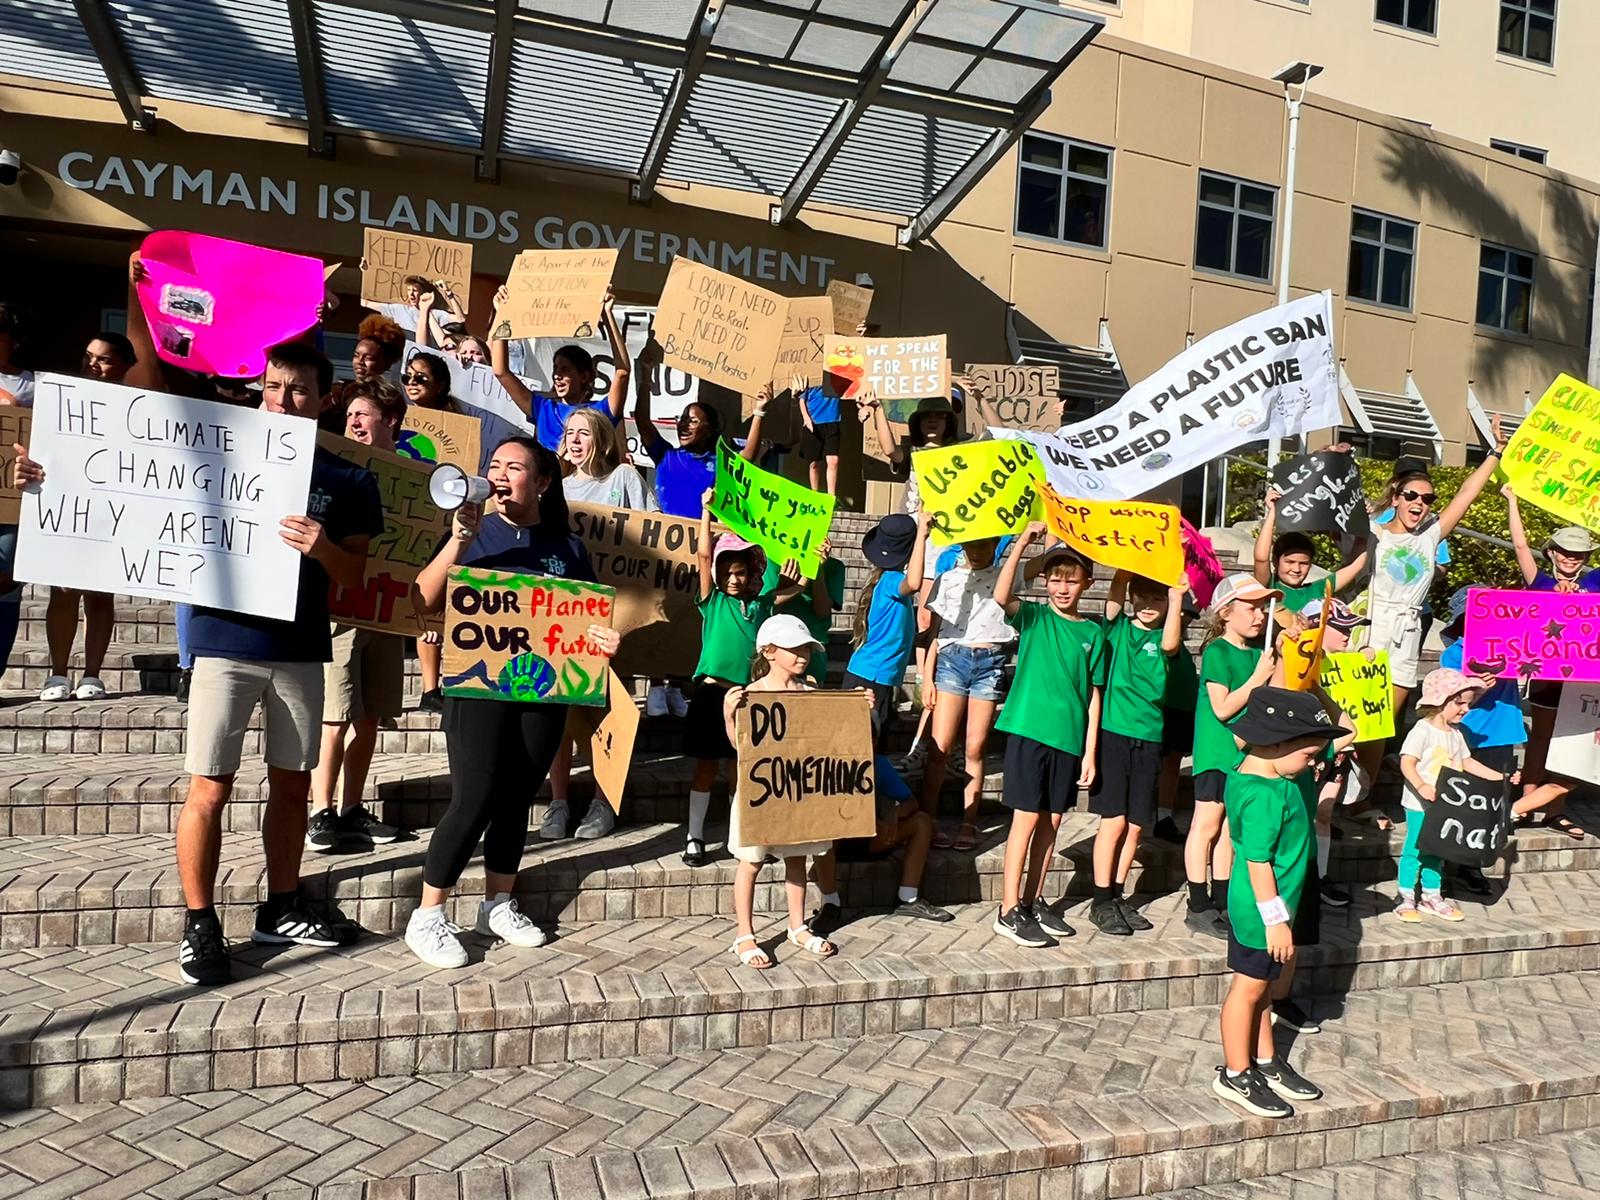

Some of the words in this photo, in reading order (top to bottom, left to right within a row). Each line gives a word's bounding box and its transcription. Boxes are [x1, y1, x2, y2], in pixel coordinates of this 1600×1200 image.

[58, 152, 296, 215] CAYMAN
[318, 184, 519, 244] ISLANDS
[534, 216, 835, 288] GOVERNMENT
[368, 231, 421, 269] KEEP
[425, 242, 463, 277] YOUR
[518, 276, 589, 292] SOLUTION
[687, 271, 696, 291] I
[699, 275, 737, 303] DON'T
[740, 290, 777, 316] NEED
[516, 311, 580, 327] OLLUTION
[693, 296, 710, 315] TO
[712, 304, 726, 321] Be
[677, 311, 687, 332] I
[693, 318, 728, 345] NEED
[730, 332, 748, 352] TO
[865, 344, 889, 357] WE
[896, 340, 940, 354] SPEAK
[867, 374, 940, 395] TREES
[872, 359, 902, 375] FOR
[909, 356, 939, 372] THE
[1053, 424, 1120, 449] EED
[1128, 410, 1150, 430] A
[1149, 335, 1266, 414] PLASTIC
[1264, 313, 1327, 347] BAN
[42, 381, 107, 437] THE
[126, 394, 235, 452] CLIMATE
[265, 428, 298, 462] IS
[1045, 445, 1089, 471] WE
[1090, 428, 1172, 471] NEED
[1179, 413, 1204, 436] A
[1201, 357, 1303, 421] FUTURE
[84, 448, 265, 502] CHANGING
[923, 455, 969, 494] Use
[1272, 456, 1325, 496] Less
[1509, 437, 1562, 470] REEF
[1562, 458, 1600, 490] SAF
[722, 452, 752, 500] Tidy
[759, 487, 780, 512] up
[785, 498, 827, 519] your
[932, 442, 1033, 540] Reusable
[1530, 469, 1600, 513] SUNSCR
[38, 493, 126, 537] WHY
[158, 511, 260, 554] AREN'T
[571, 511, 629, 546] SN'T
[720, 490, 812, 559] plastics!
[1109, 508, 1171, 531] using
[121, 546, 207, 587] WE?
[612, 555, 650, 580] OUR
[653, 558, 702, 593] HOM
[451, 585, 521, 616] OUR
[530, 586, 611, 618] Planet
[1471, 591, 1541, 620] Save
[451, 621, 533, 654] OUR
[543, 623, 609, 657] futu
[1320, 660, 1345, 688] uit
[1352, 664, 1388, 688] using
[750, 702, 787, 747] DO
[749, 756, 873, 807] SOMETHING
[1441, 776, 1505, 811] Sav
[1440, 818, 1500, 850] nat
